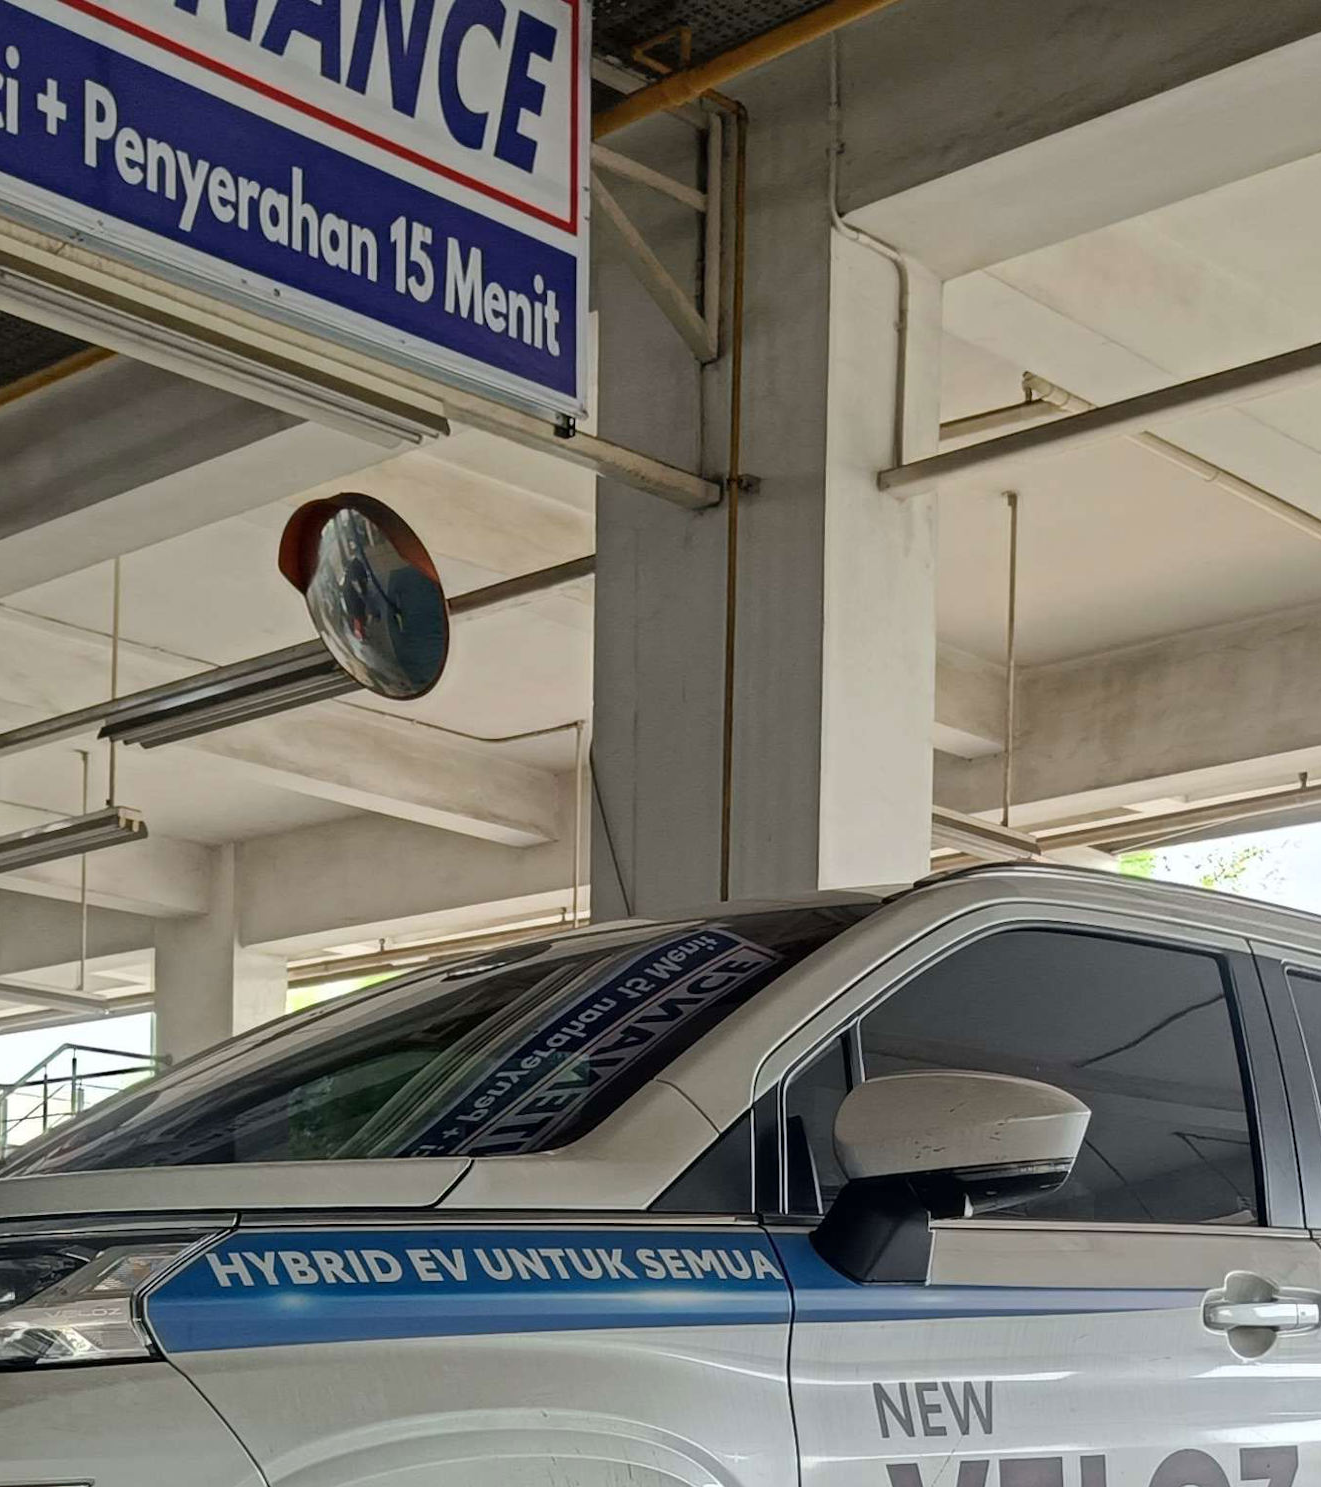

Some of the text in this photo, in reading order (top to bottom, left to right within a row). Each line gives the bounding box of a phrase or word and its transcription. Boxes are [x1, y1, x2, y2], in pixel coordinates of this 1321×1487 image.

[175, 0, 558, 174] ANCE
[36, 80, 66, 135] +
[83, 78, 378, 283] Penyerahan
[389, 215, 435, 302] 15
[443, 236, 561, 357] Menit
[206, 1247, 784, 1287] HYBRID EV UNTUK SEMUA
[44, 1308, 123, 1320] VELOZ
[873, 1381, 993, 1438] NEW
